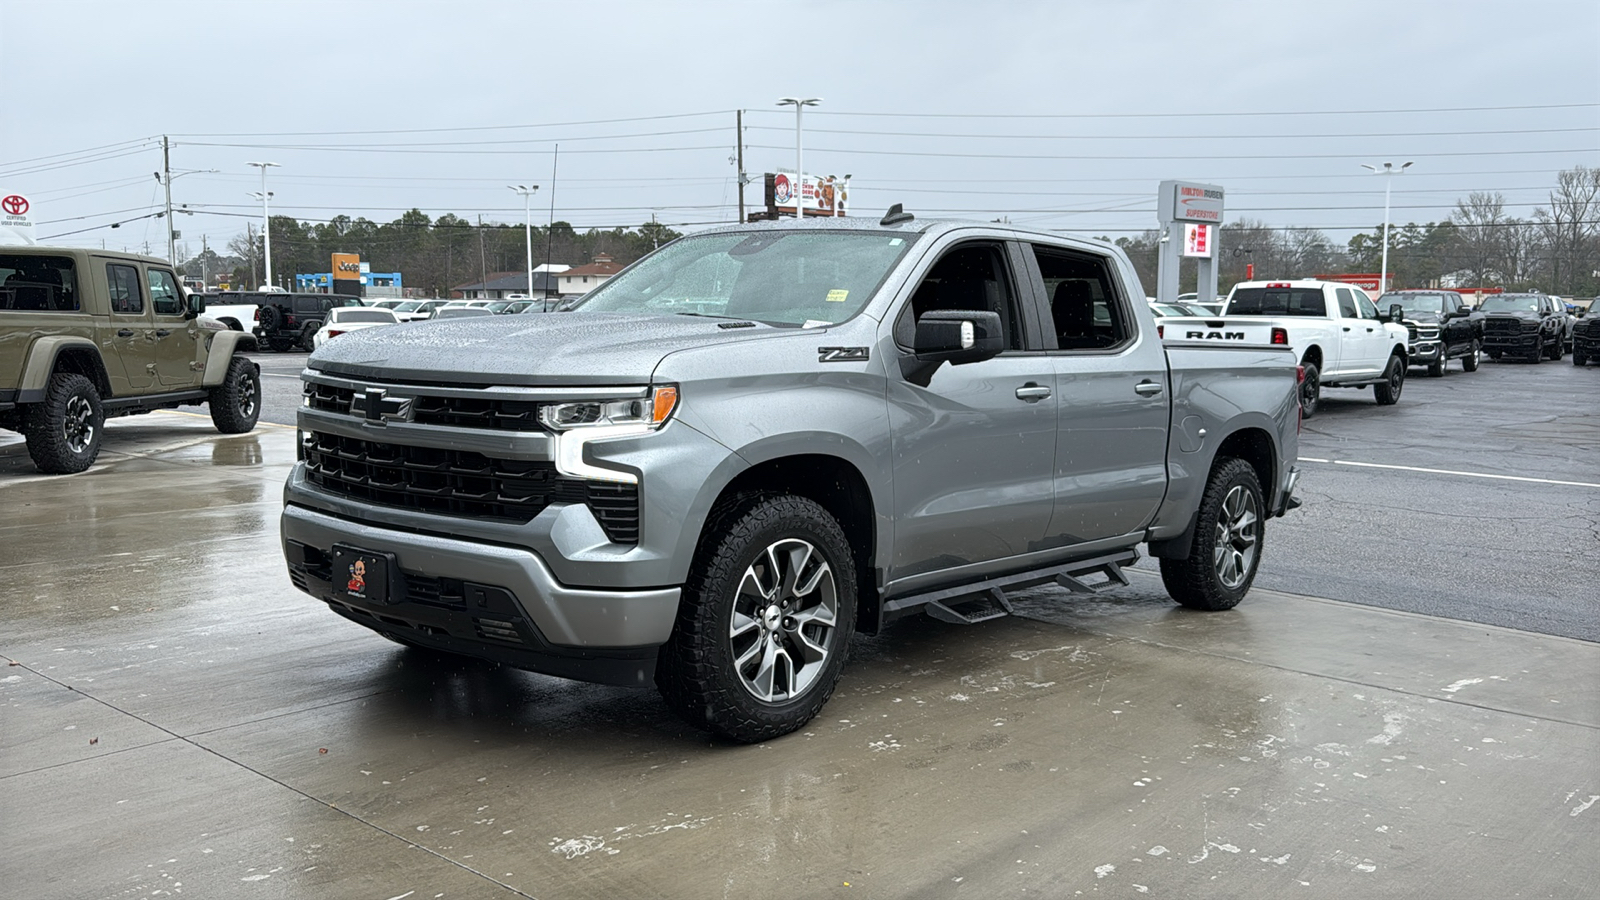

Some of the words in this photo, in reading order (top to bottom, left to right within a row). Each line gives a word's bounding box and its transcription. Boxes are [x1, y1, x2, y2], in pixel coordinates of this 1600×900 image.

[1181, 187, 1203, 197] MILTON
[1204, 189, 1223, 200] RUBEN
[1186, 209, 1219, 219] SUPERSTORE
[338, 260, 360, 273] Jeep
[1186, 331, 1245, 340] RAM
[818, 346, 869, 363] Z71
